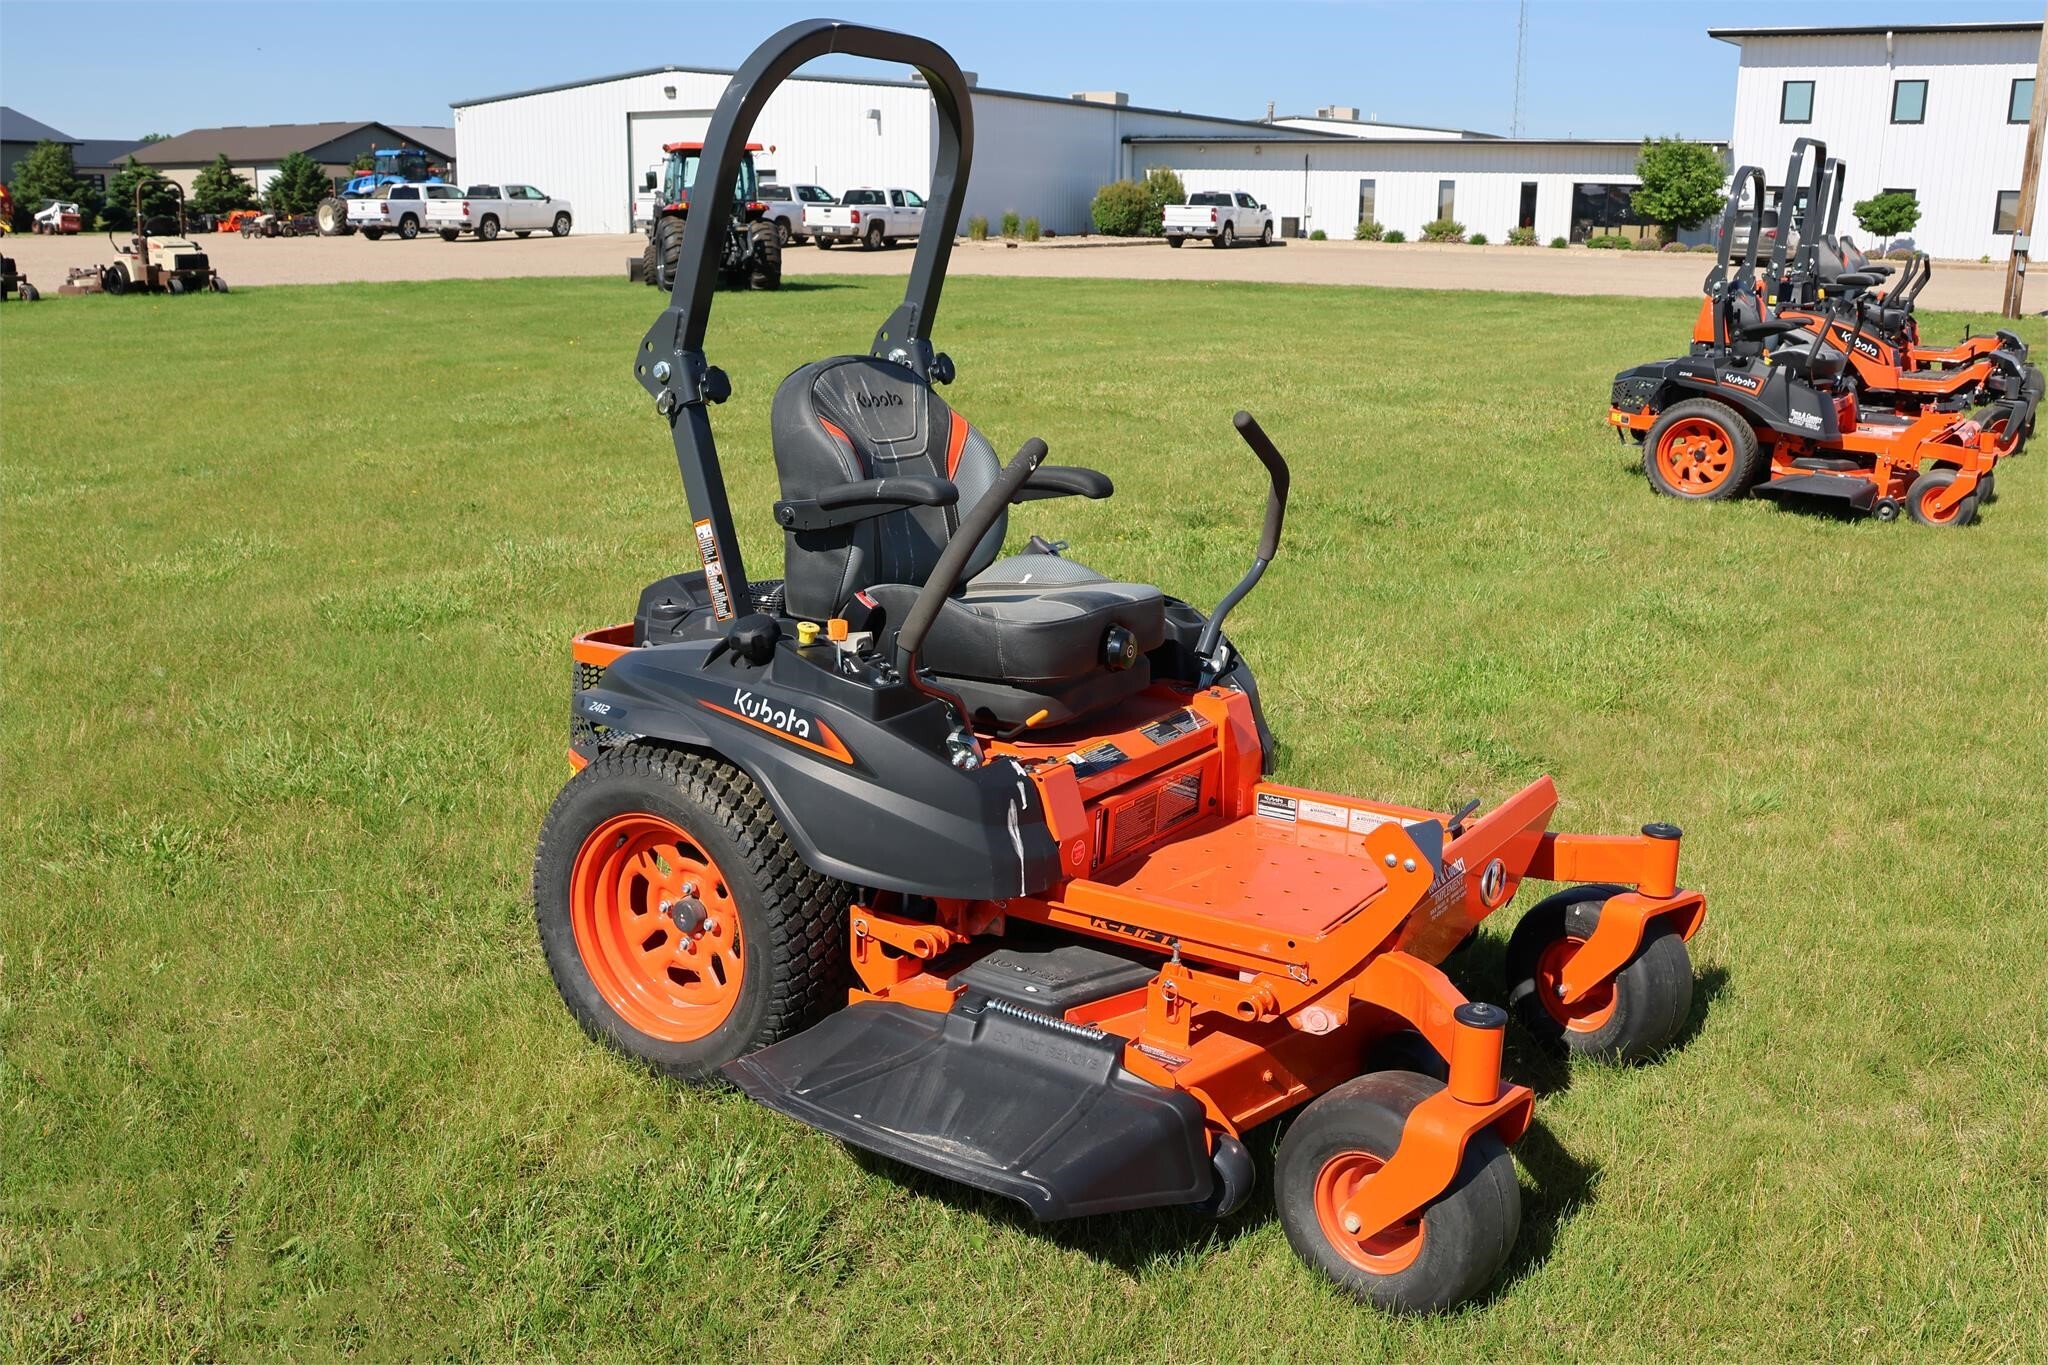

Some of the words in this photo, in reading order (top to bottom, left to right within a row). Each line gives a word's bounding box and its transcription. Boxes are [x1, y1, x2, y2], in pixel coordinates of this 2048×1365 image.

[1725, 373, 1757, 388] Kubota
[857, 390, 903, 408] Kubota
[588, 701, 611, 715] Z412
[734, 688, 810, 738] Kubota
[1093, 919, 1170, 945] K-LIFT
